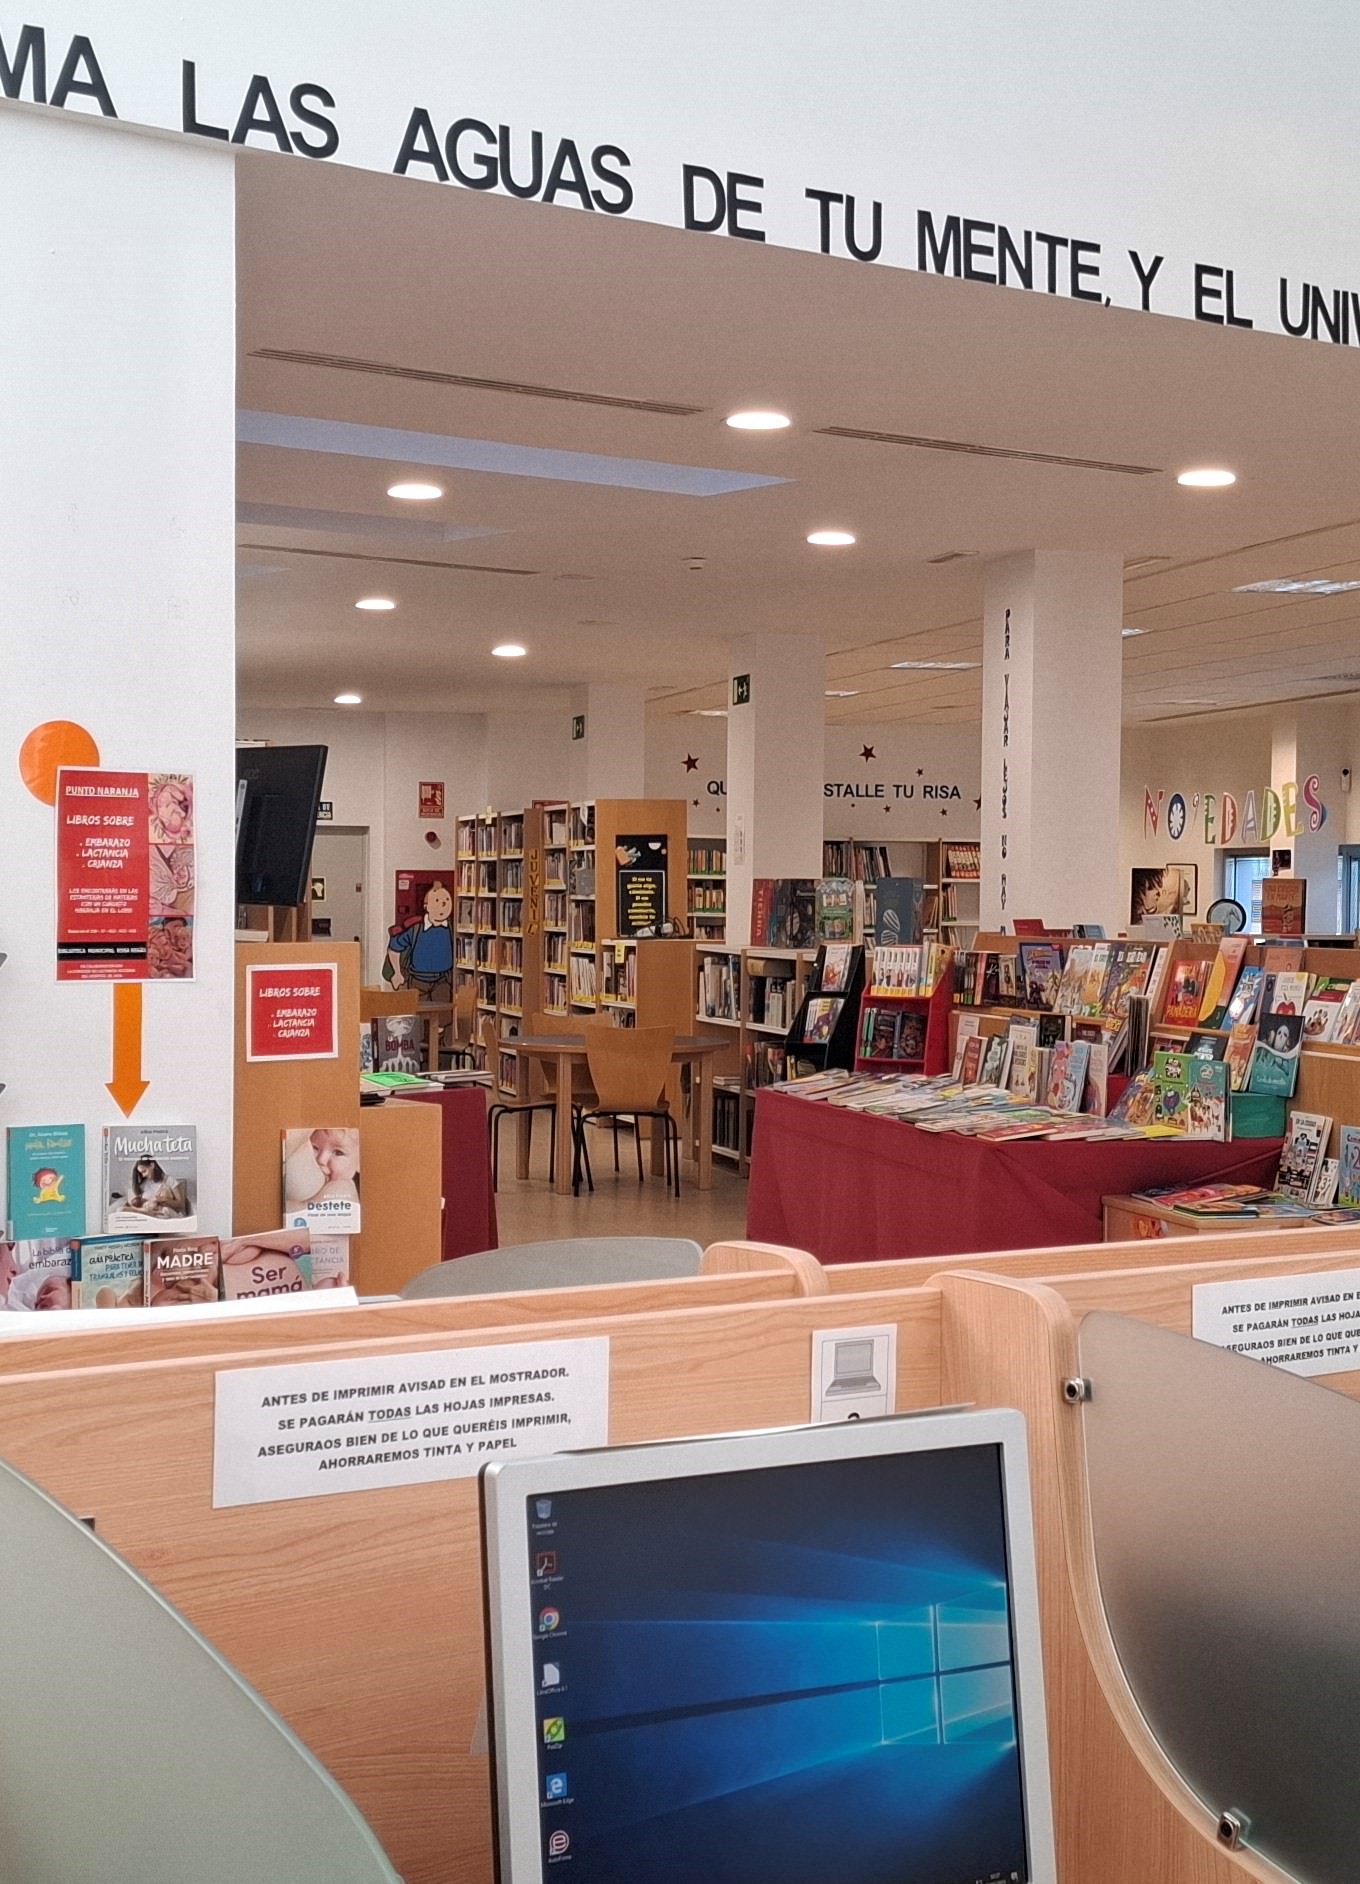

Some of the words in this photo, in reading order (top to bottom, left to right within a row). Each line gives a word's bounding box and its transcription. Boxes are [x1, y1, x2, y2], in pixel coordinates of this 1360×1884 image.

[181, 60, 339, 160] LAS
[392, 107, 633, 215] AGUAS
[682, 163, 766, 242] DE
[805, 188, 882, 262] TU
[917, 209, 1111, 308] MENTE,
[1128, 249, 1164, 311] Y
[1194, 263, 1253, 329] EL
[66, 786, 96, 796] PUNTO
[97, 786, 139, 797] NARANJA
[893, 784, 914, 799] TU
[923, 784, 961, 800] RISA
[67, 816, 100, 825] LIBROS
[103, 816, 135, 826] SOBRE
[85, 838, 131, 847] EMBARAZO
[82, 849, 129, 858] LACTANCIA
[527, 849, 539, 935] JUVENIL
[259, 988, 291, 998] LIBROS
[293, 986, 321, 997] SOBRE
[114, 1136, 163, 1155] Mucha
[157, 1252, 214, 1269] MADRE
[252, 1266, 287, 1284] Ser
[1221, 1303, 1252, 1314] ANTES
[1254, 1302, 1266, 1311] DE
[1268, 1297, 1309, 1309] IMPRIMIR
[1310, 1293, 1341, 1304] AVISAD
[1342, 1292, 1354, 1301] EN
[1232, 1323, 1244, 1332] SE
[1246, 1318, 1289, 1331] PAGARÁN
[1291, 1315, 1319, 1326] TODAS
[1321, 1312, 1337, 1322] LAS
[1277, 1337, 1298, 1347] BIEN
[1299, 1335, 1311, 1344] DE
[1312, 1333, 1324, 1342] LO
[1325, 1331, 1343, 1340] QUE
[1326, 1345, 1351, 1355] TINTA
[1352, 1343, 1359, 1352] Y
[261, 1392, 308, 1407] ANTES
[311, 1390, 329, 1402] DE
[333, 1384, 395, 1400] IMPRIMIR
[398, 1379, 446, 1393] AVISAD
[449, 1376, 467, 1388] EN
[470, 1375, 486, 1385] EL
[489, 1367, 569, 1384] MOSTRADOR.
[278, 1418, 295, 1430] SE
[299, 1411, 364, 1427] PAGARÁN
[368, 1406, 412, 1420] TODAS
[415, 1403, 440, 1415] LAS
[443, 1398, 486, 1412] HOJAS
[489, 1391, 555, 1407] IMPRESAS.
[257, 1438, 342, 1457] ASEGURAOS
[346, 1434, 377, 1447] BIEN
[381, 1431, 398, 1443] DE
[401, 1429, 419, 1440] LO
[422, 1425, 449, 1437] QUE
[452, 1419, 508, 1434] QUERÉIS
[511, 1413, 571, 1428] IMPRIMIR,
[318, 1450, 420, 1470] AHORRAREMOS
[423, 1444, 462, 1456] TINTA
[466, 1441, 474, 1452] Y
[478, 1437, 517, 1451] PAPEL
